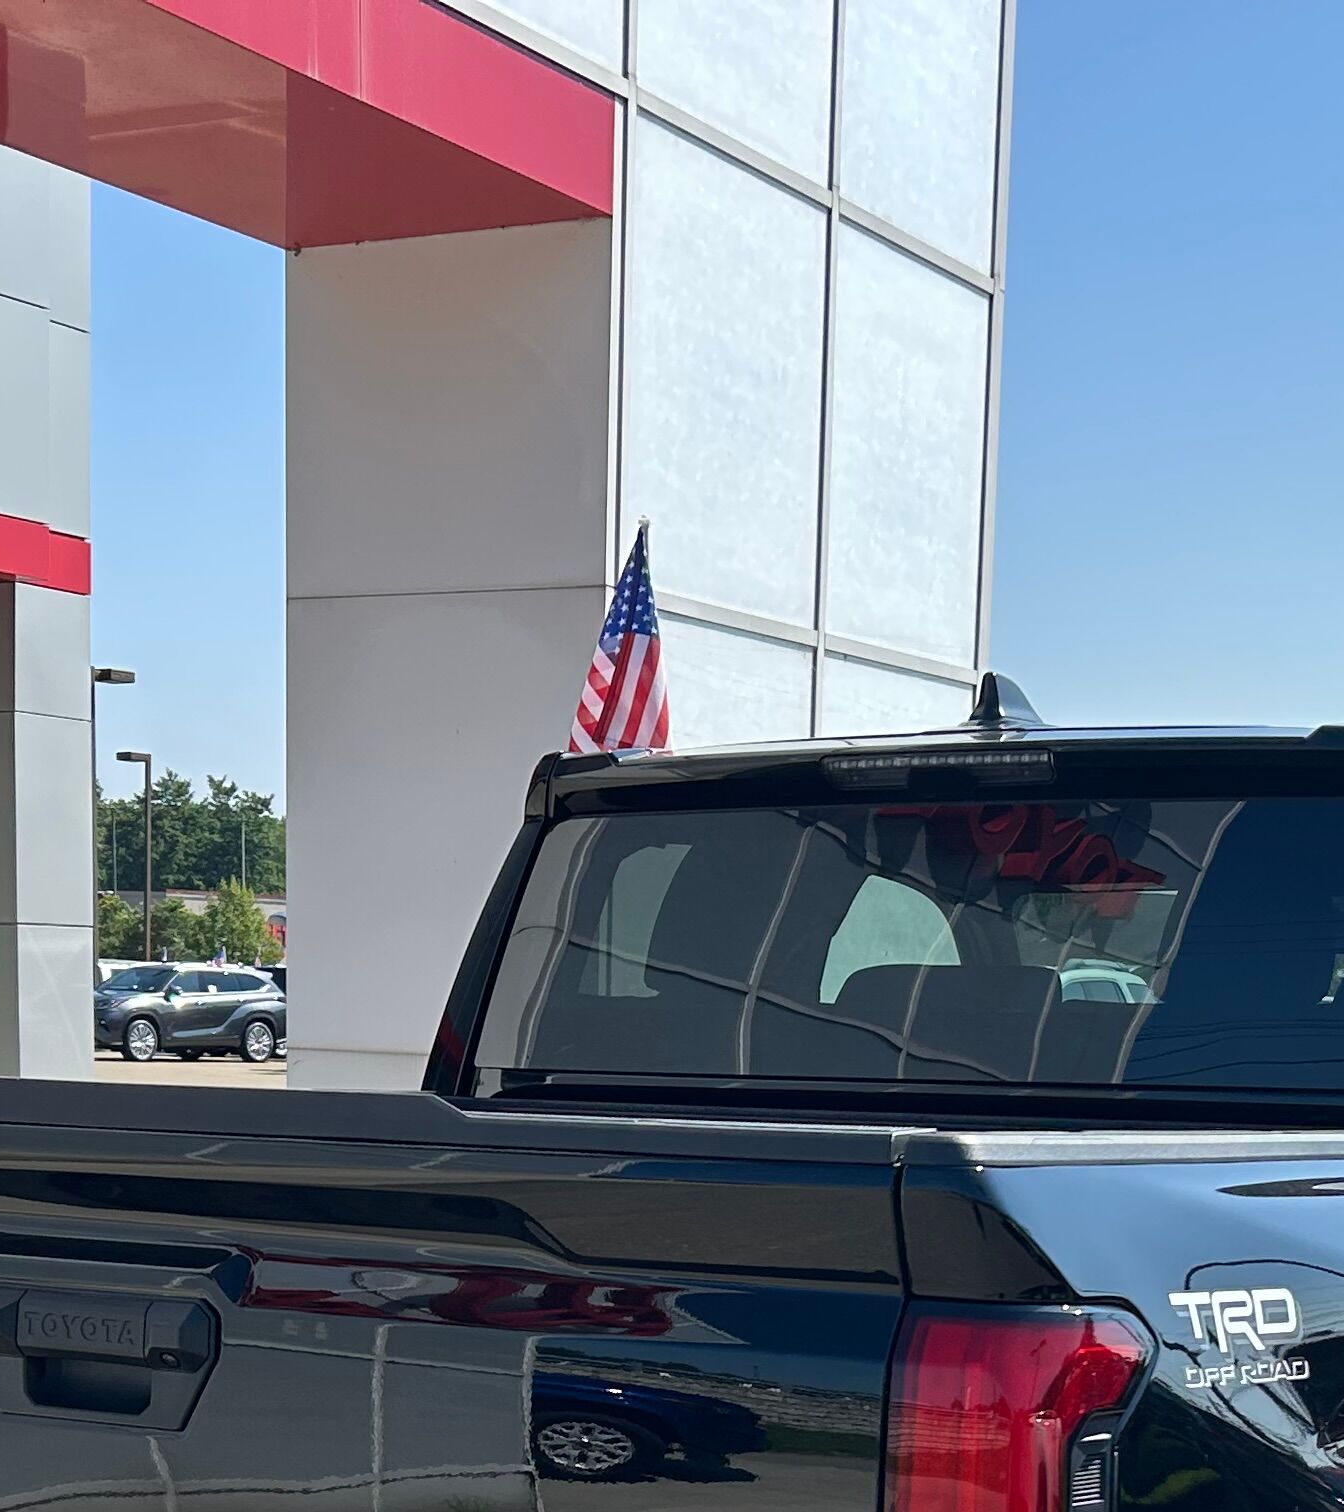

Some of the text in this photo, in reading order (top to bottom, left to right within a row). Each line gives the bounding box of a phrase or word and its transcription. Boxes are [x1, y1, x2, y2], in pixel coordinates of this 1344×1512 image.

[24, 1311, 137, 1345] TOYOTA
[1168, 1287, 1297, 1354] TRD
[1185, 1359, 1311, 1389] OFF ROAD
